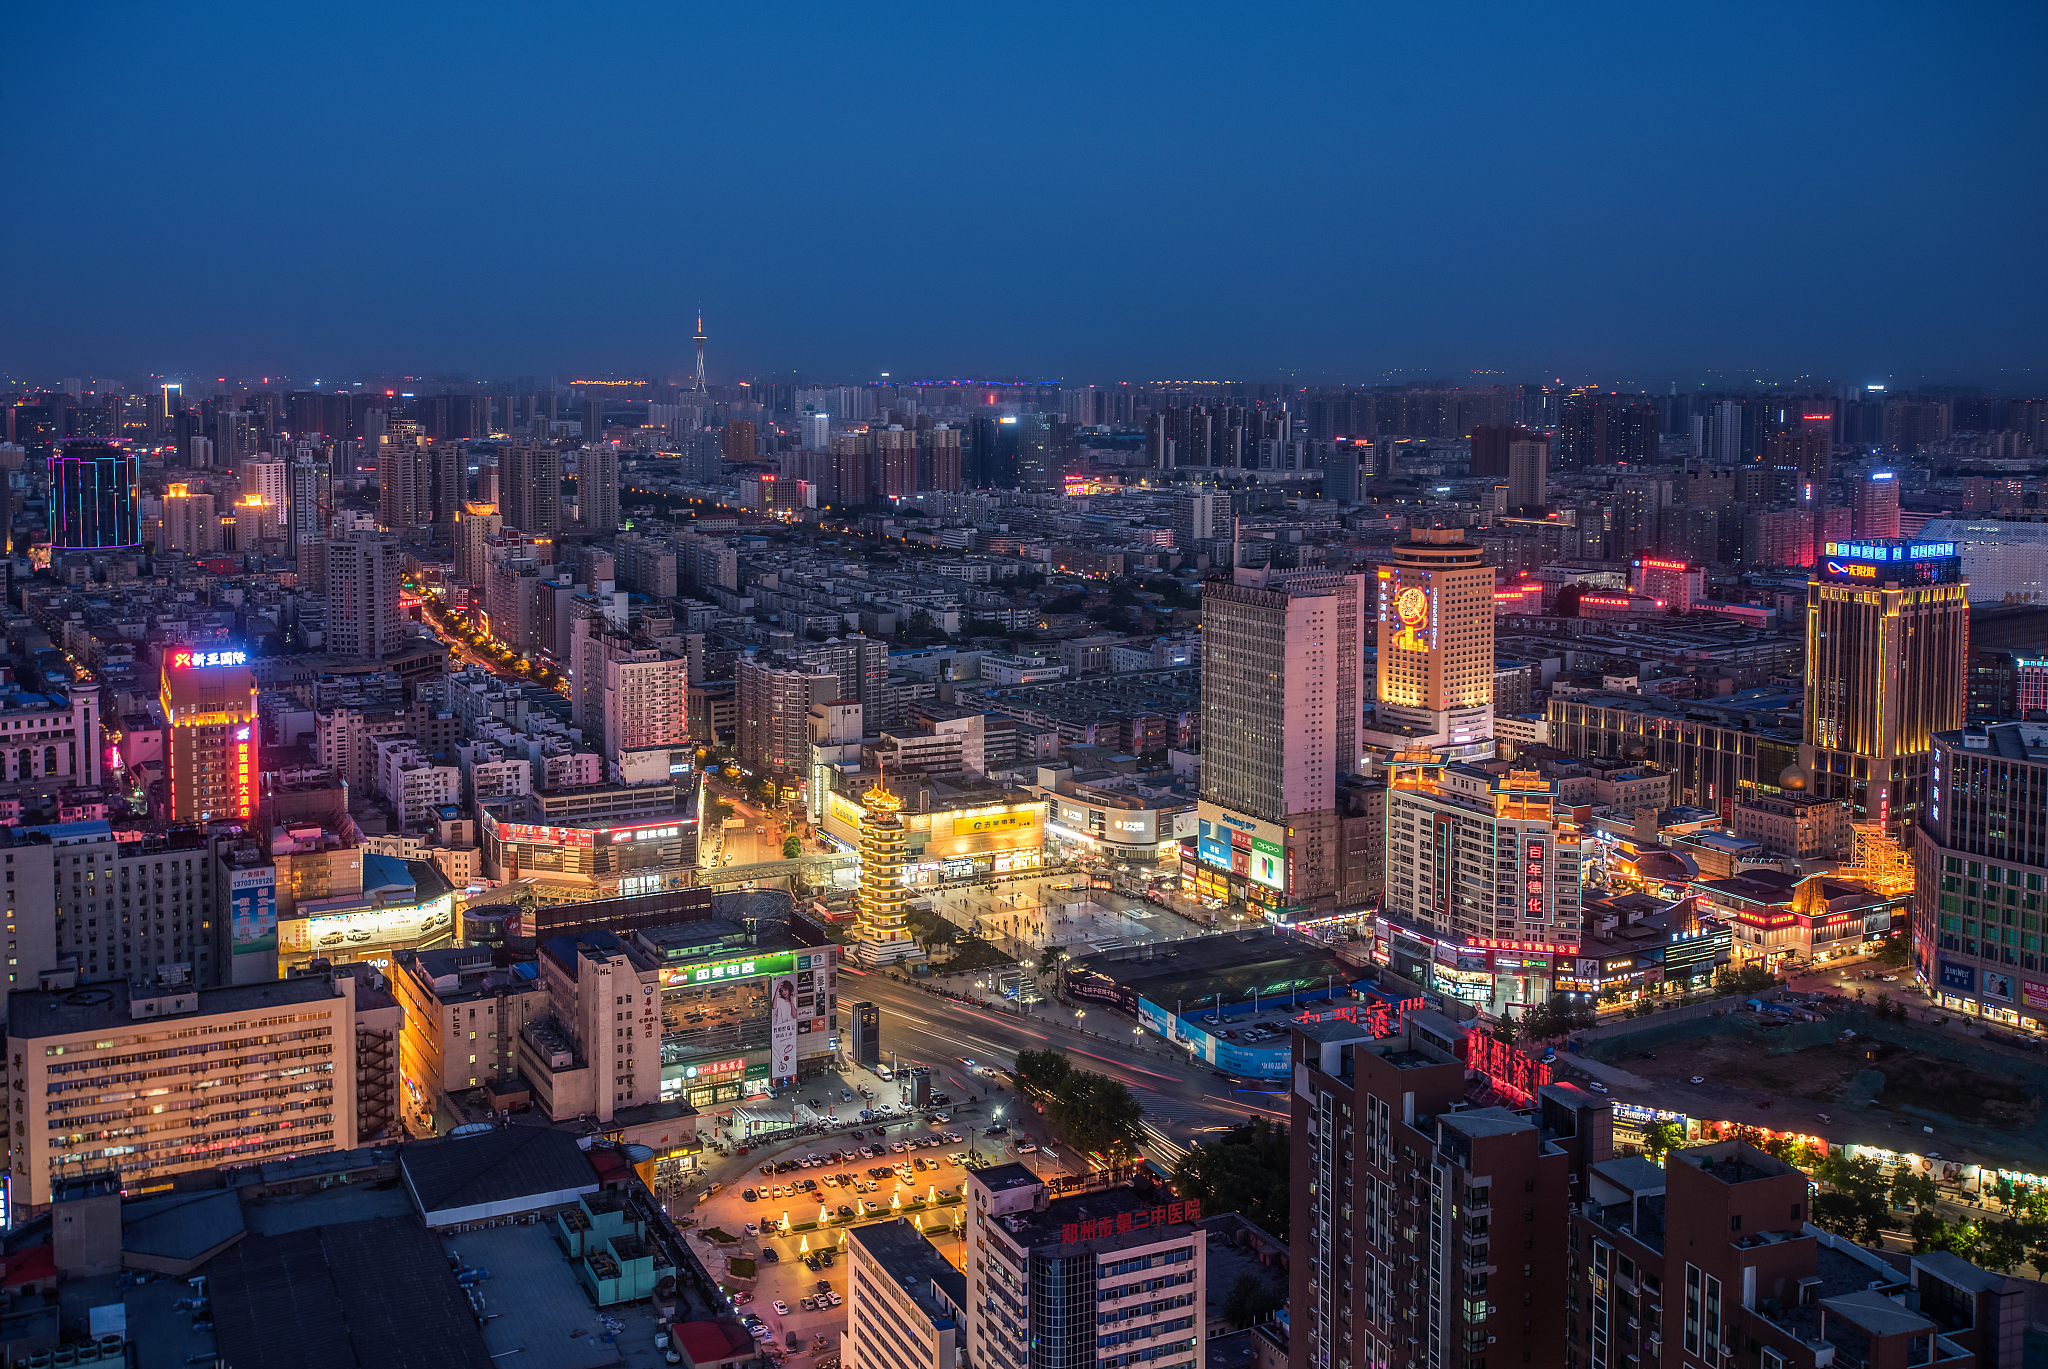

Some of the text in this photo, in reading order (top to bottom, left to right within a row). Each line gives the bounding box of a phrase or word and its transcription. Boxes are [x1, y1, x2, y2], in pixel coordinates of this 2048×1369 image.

[191, 652, 246, 667] 新亚国际
[238, 743, 249, 818] 新亚国际大酒店
[1222, 813, 1245, 830] Suning
[1528, 846, 1542, 911] 百年德化
[1466, 938, 1577, 954] 百年德化风情购物公园
[696, 962, 755, 981] 国美电器
[452, 1007, 460, 1037] HLSS
[1061, 1197, 1201, 1246] 郑州市第二中医院
